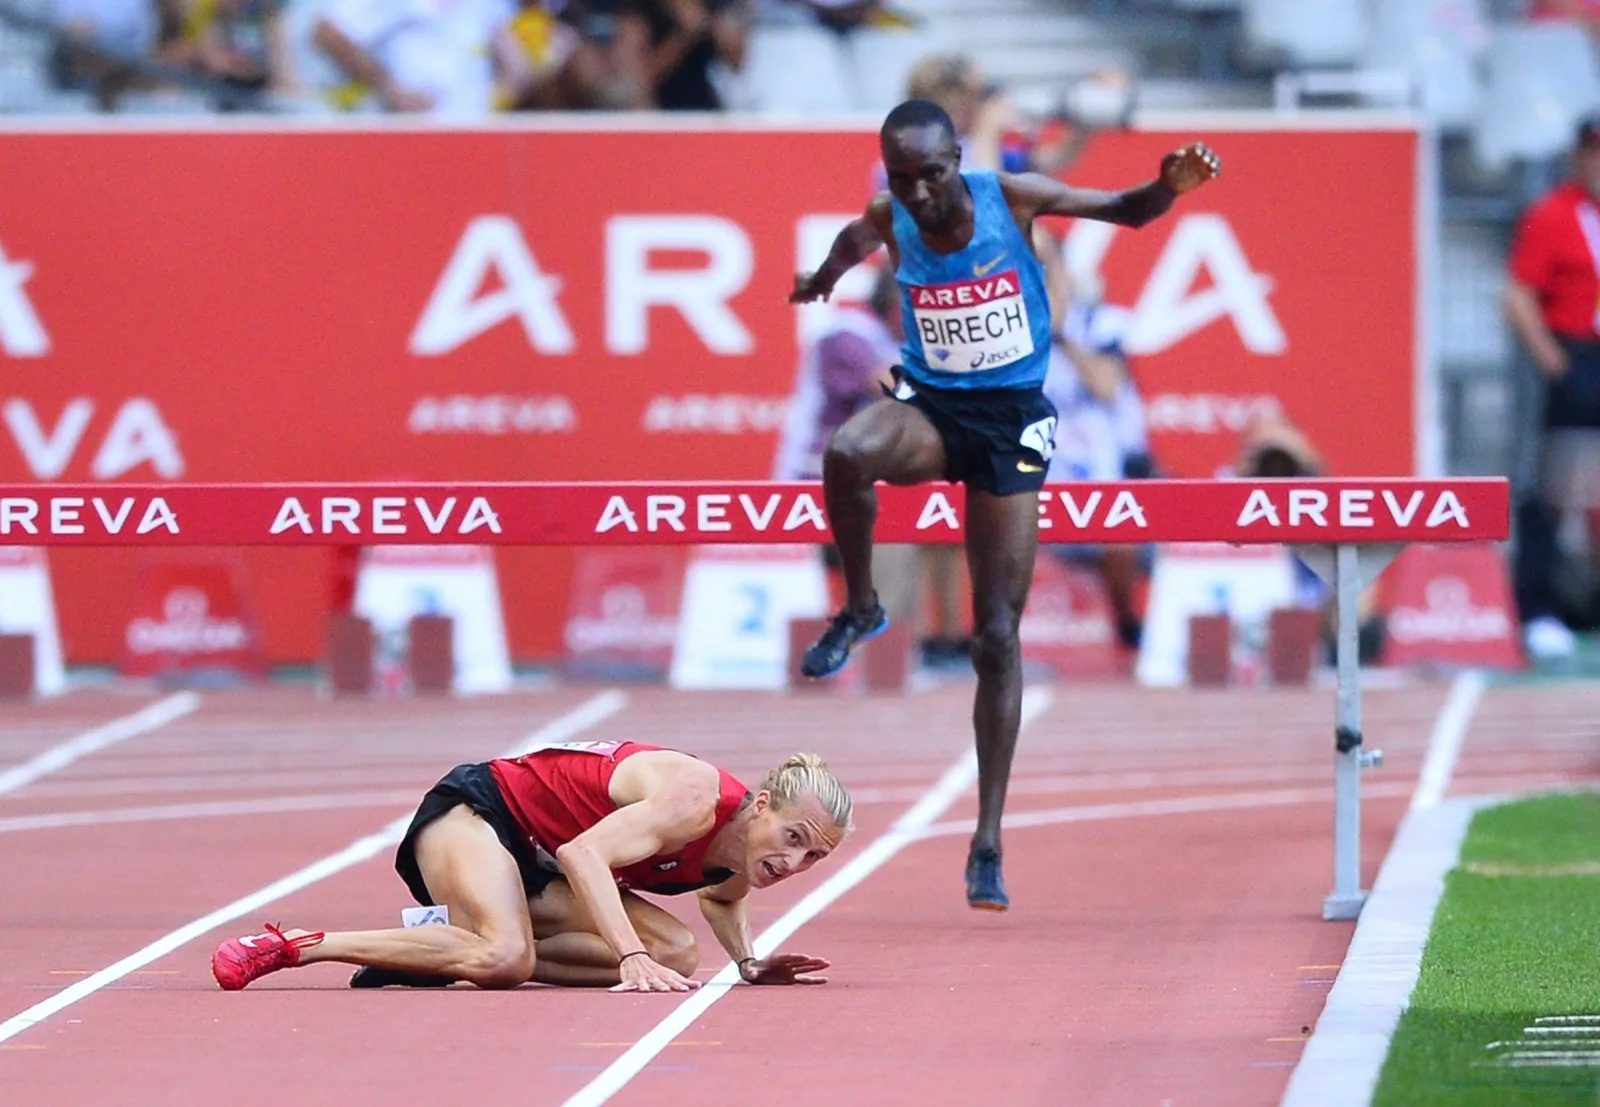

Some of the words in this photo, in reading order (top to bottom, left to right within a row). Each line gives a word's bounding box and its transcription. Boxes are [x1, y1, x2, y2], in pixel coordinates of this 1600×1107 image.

[409, 213, 1289, 355] ARA
[918, 278, 1015, 306] AREVA
[920, 304, 1024, 345] BIRECH
[0, 497, 180, 534] REVA
[269, 496, 502, 534] AREVA
[595, 493, 828, 532] AREVA
[916, 490, 1148, 529] AVA
[1236, 489, 1470, 528] AREVA
